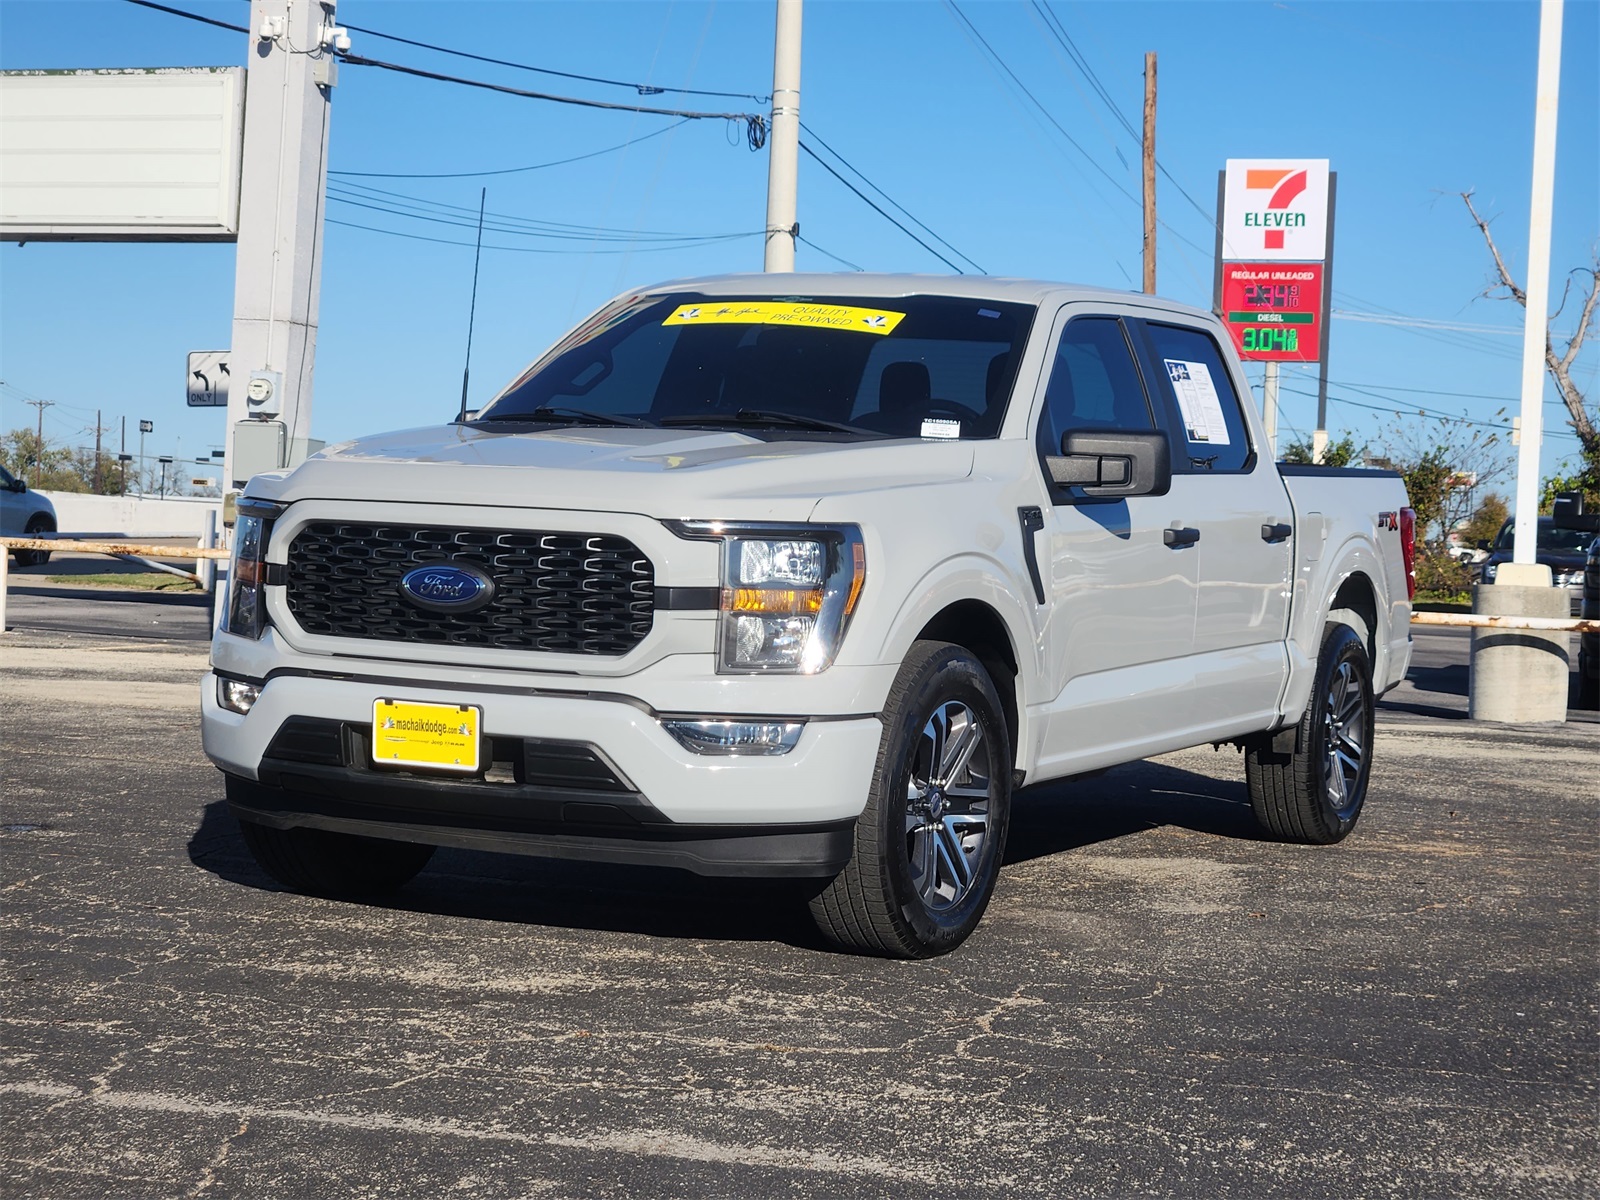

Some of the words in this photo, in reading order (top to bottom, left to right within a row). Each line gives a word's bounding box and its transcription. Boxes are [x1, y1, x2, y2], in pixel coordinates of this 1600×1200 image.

[1246, 169, 1308, 209] 7
[1231, 270, 1270, 280] REGULAR
[1271, 271, 1315, 281] UNLEADED
[793, 306, 853, 316] QUALITY
[1257, 313, 1284, 322] DIESEL
[770, 313, 853, 326] PRE-OWNED
[1242, 327, 1287, 351] 3.04
[190, 392, 212, 403] ONLY
[1378, 511, 1398, 531] STX
[420, 574, 464, 596] Ford
[396, 718, 458, 736] machaikdodge.com
